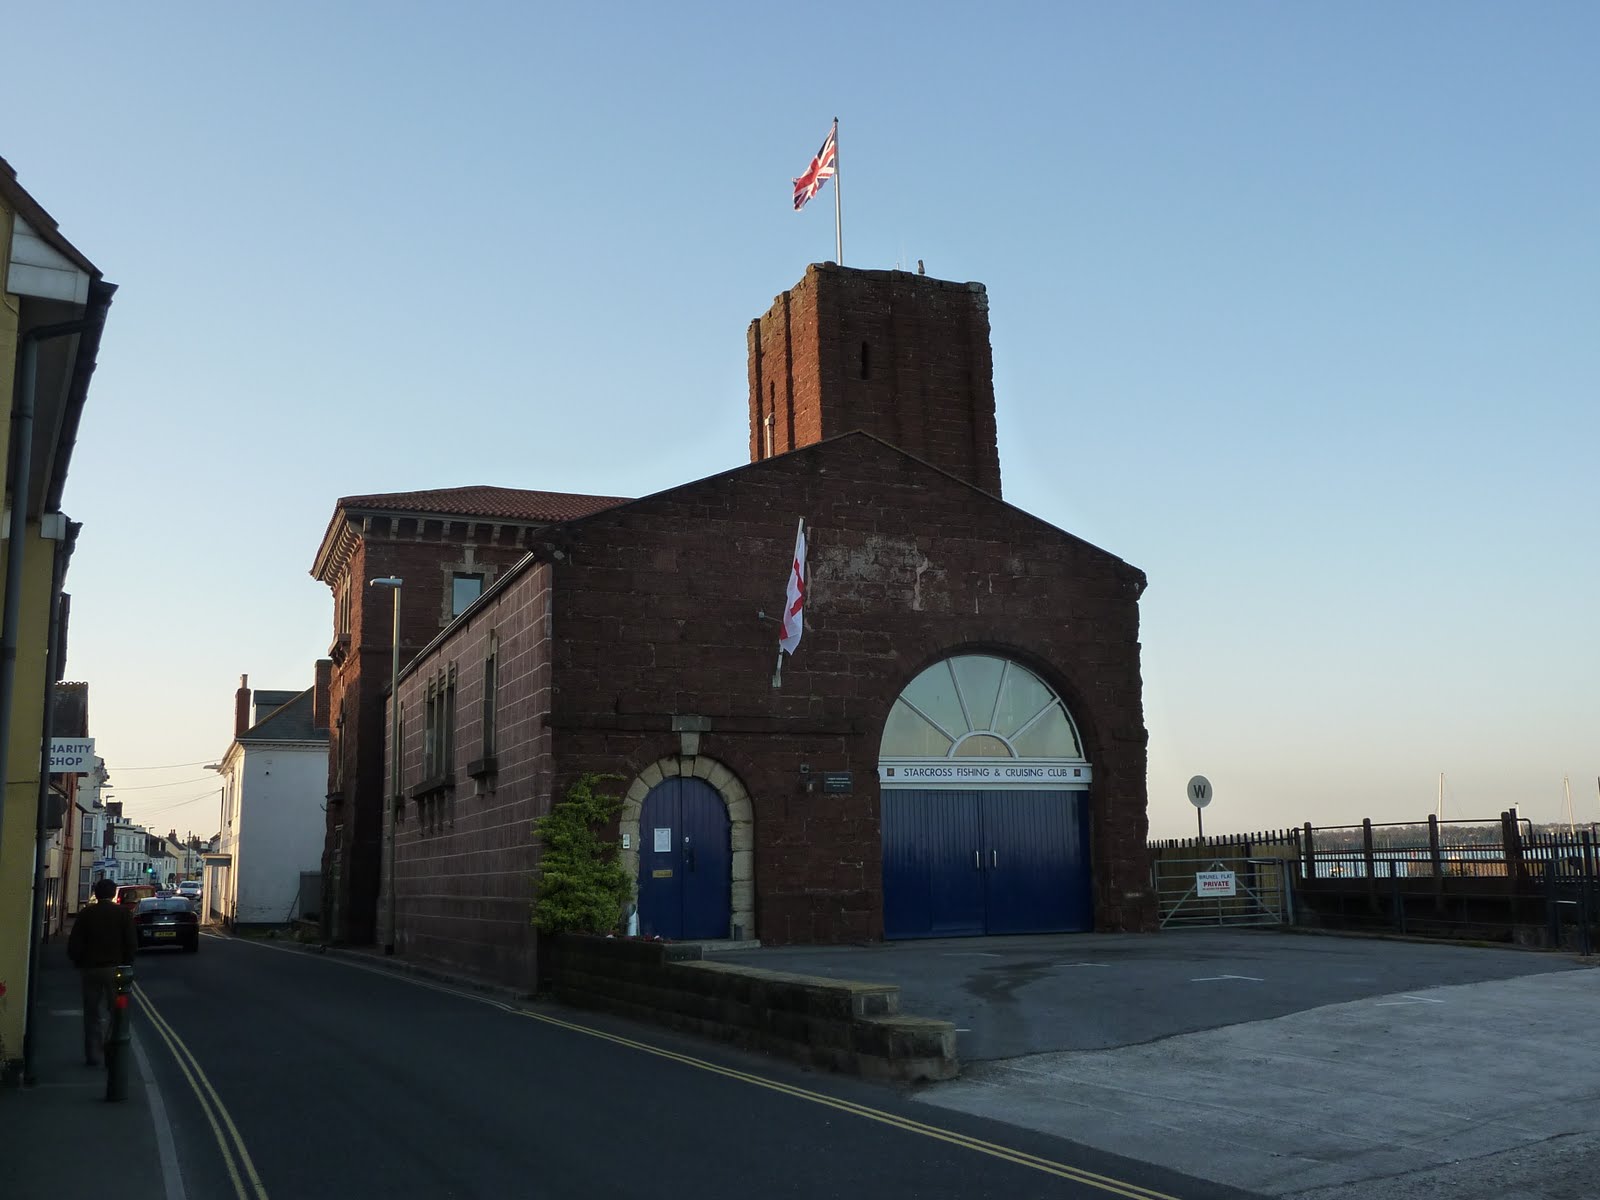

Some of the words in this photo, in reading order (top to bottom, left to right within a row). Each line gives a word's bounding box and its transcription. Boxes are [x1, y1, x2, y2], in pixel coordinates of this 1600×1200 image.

[50, 744, 91, 753] HARITY
[49, 757, 83, 766] SHOP
[903, 767, 953, 777] STARCROSS
[956, 767, 990, 777] FISHING
[994, 768, 1001, 777] &
[1005, 768, 1044, 777] CRUISING
[1047, 768, 1068, 777] CLUB
[1193, 784, 1206, 799] W
